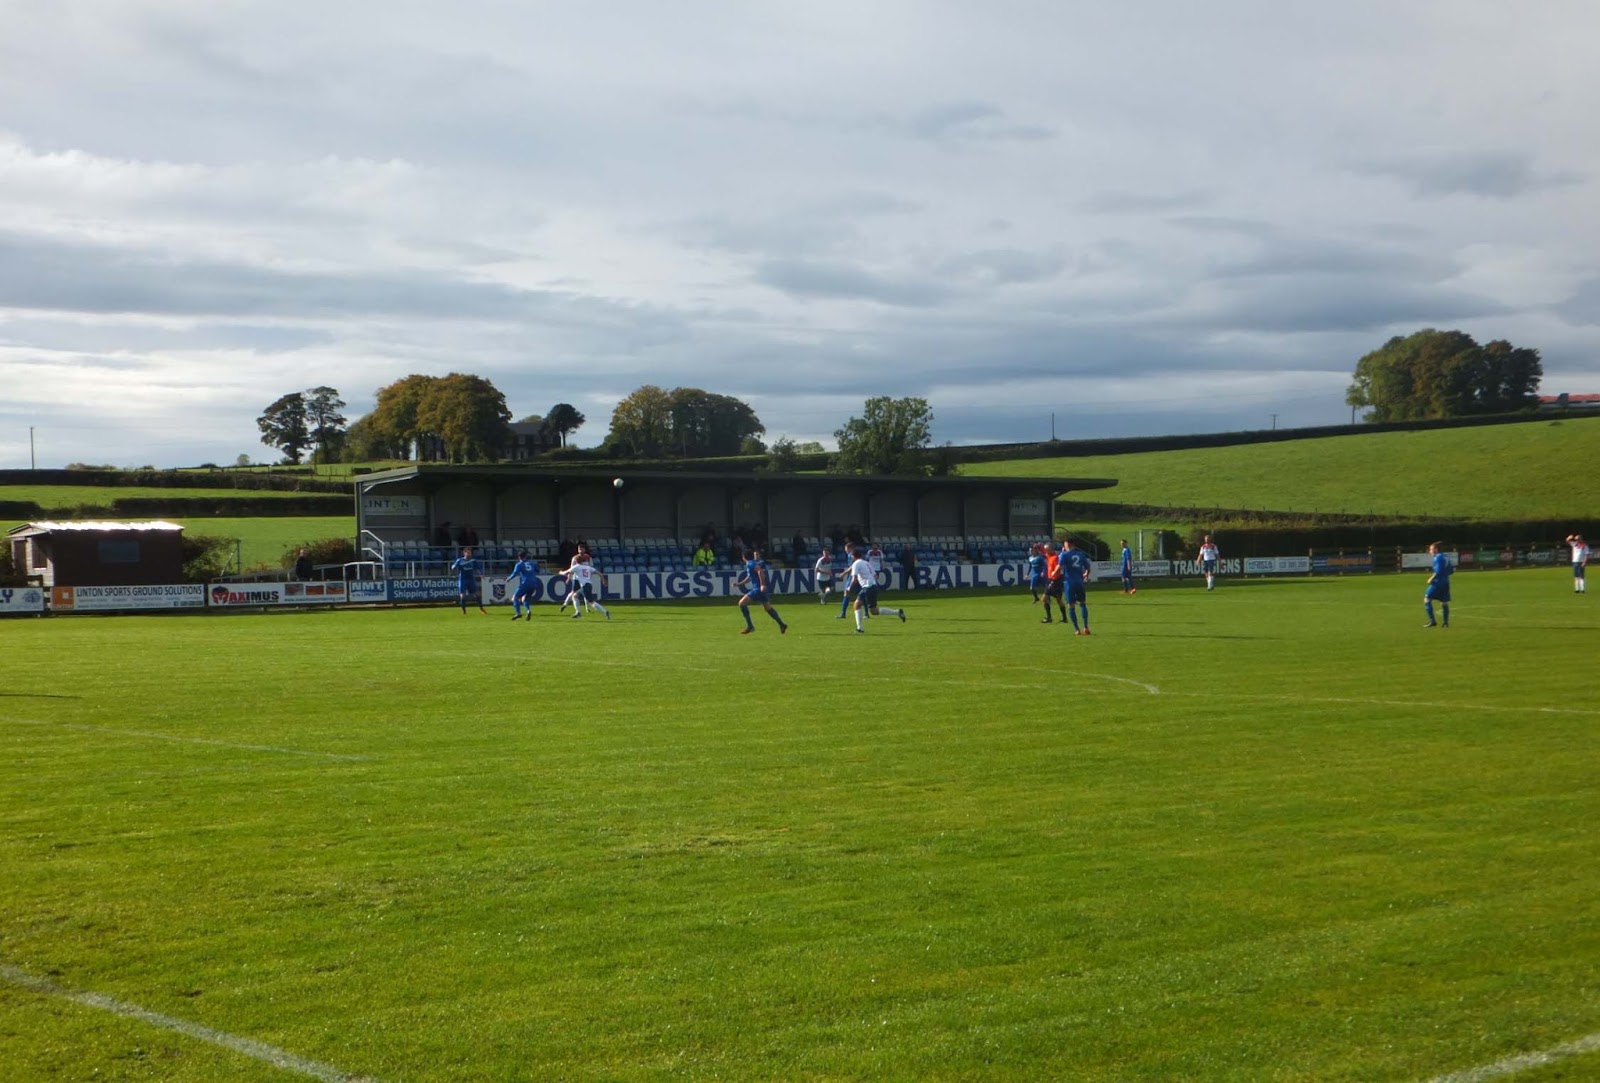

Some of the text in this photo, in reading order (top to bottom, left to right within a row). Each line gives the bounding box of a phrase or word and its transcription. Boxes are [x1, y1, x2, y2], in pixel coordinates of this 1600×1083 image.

[1071, 555, 1080, 567] 2
[524, 562, 532, 571] 5
[351, 581, 384, 591] NMT
[393, 579, 461, 589] RORO Machine
[76, 585, 202, 598] LINTON SPORTS GROUND SOLUTIONS
[393, 589, 428, 599] Shipping
